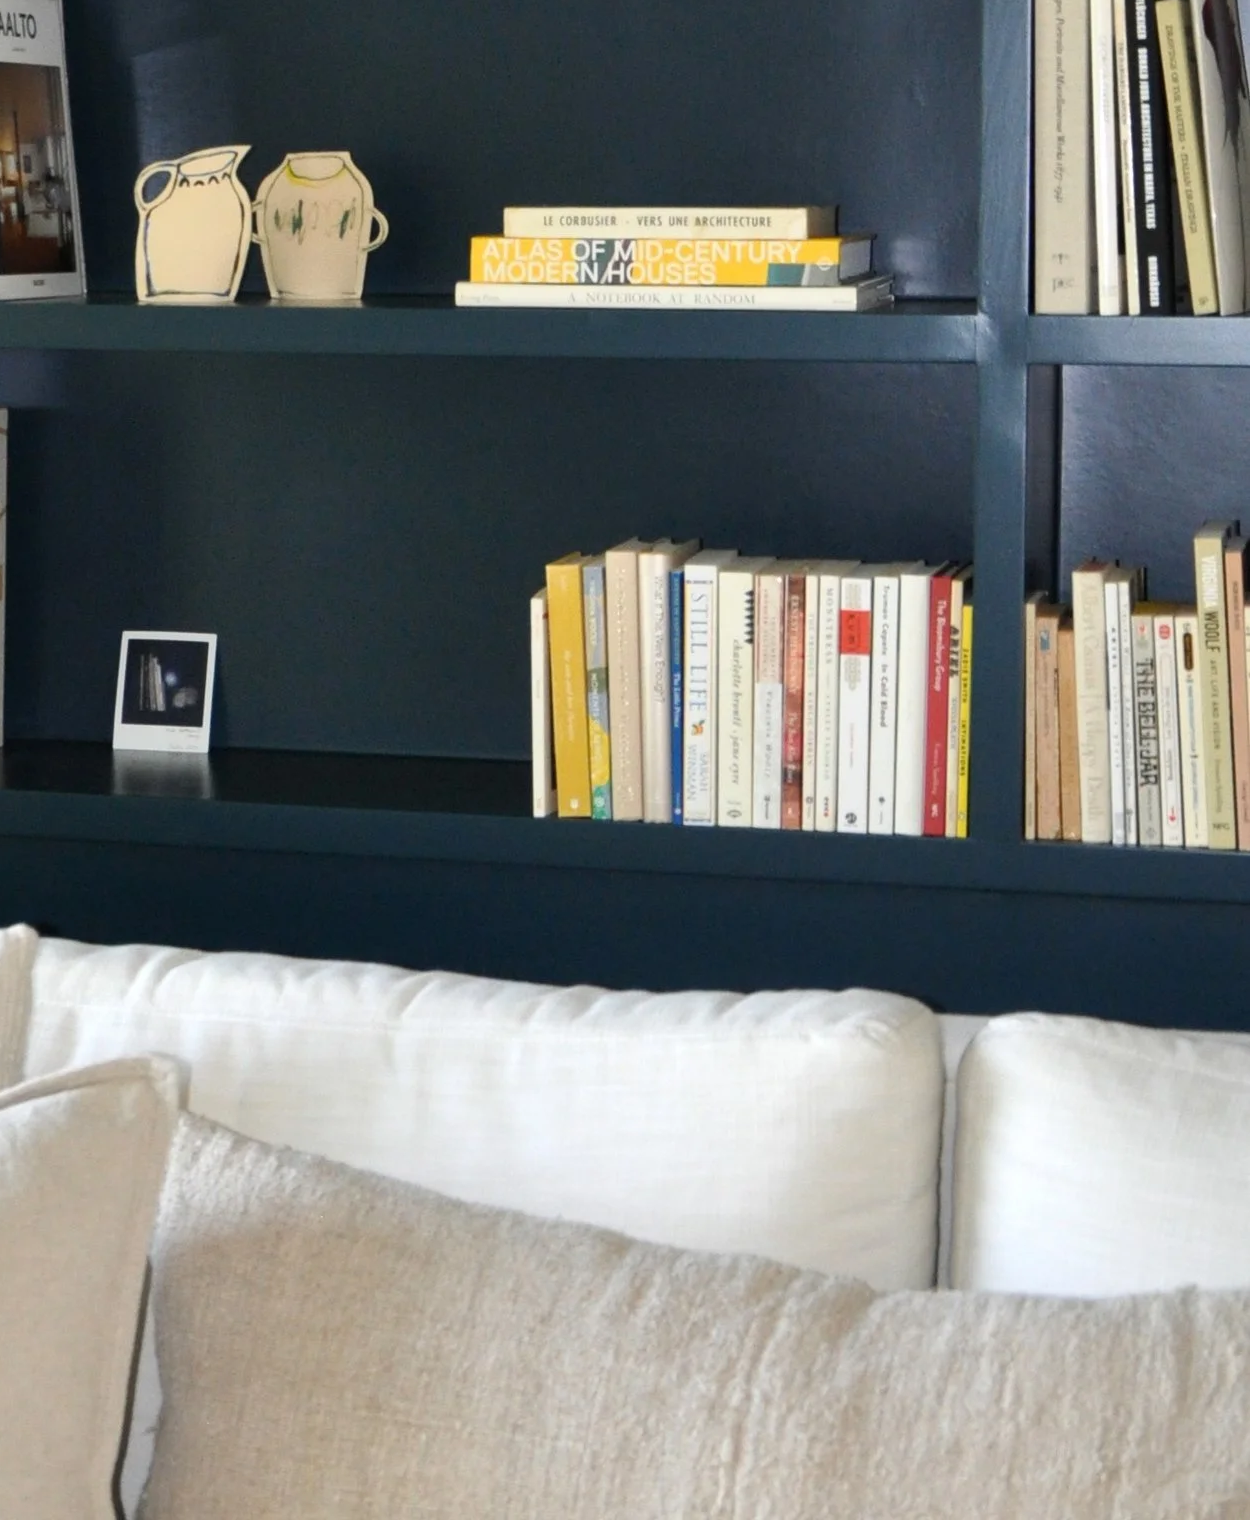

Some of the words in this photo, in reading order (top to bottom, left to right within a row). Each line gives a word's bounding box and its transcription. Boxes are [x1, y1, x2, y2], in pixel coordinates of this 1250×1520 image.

[1169, 71, 1178, 83] OF
[543, 216, 556, 227] LE
[559, 216, 618, 227] CORBUSIER
[636, 216, 663, 227] VERS
[668, 216, 690, 227] UNE
[694, 216, 772, 228] ARCHITECTURE
[482, 239, 564, 262] ATLAS
[569, 239, 606, 262] OF
[613, 239, 805, 264] MID-CENTURY
[482, 261, 599, 283] MODERN
[607, 261, 717, 286] HOUSES
[567, 293, 577, 305] A
[586, 292, 661, 305] NOTEBOOK
[668, 293, 685, 305] AT
[692, 293, 758, 306] RANDOM
[881, 584, 890, 620] Truman
[937, 599, 947, 615] The
[690, 592, 708, 654] STILL
[1203, 611, 1221, 654] WOOLF
[934, 616, 946, 664] Bloomsbury
[732, 639, 743, 689] charlotte
[673, 673, 681, 687] The
[690, 664, 708, 713] LIFE
[879, 676, 888, 697] Cold
[932, 665, 945, 692] Group
[1136, 658, 1156, 698] THE
[879, 700, 888, 727] Blood
[1136, 700, 1157, 750] BELL
[729, 734, 742, 759] jane
[959, 720, 967, 777] INTIMATIONS
[699, 750, 709, 792] SARAH
[729, 762, 740, 786] eyre
[1138, 750, 1159, 788] JAR
